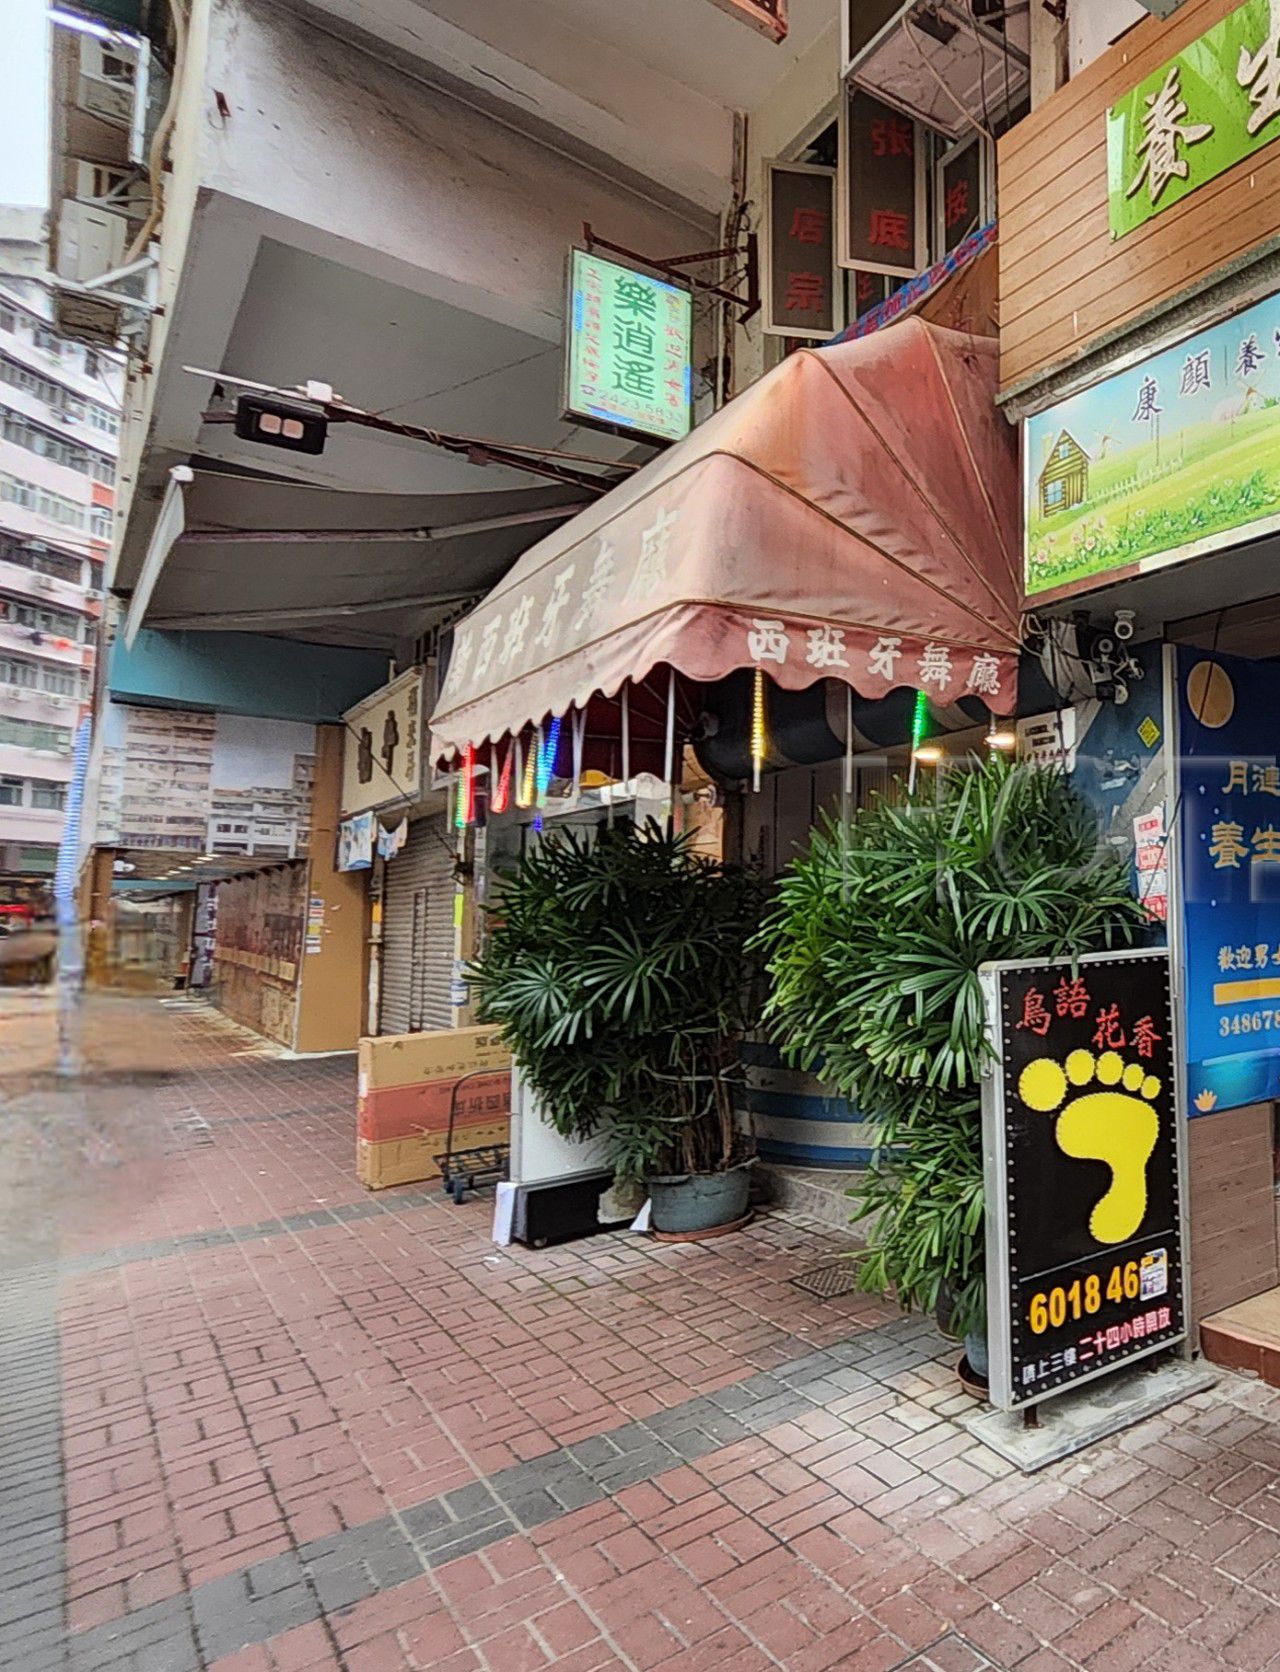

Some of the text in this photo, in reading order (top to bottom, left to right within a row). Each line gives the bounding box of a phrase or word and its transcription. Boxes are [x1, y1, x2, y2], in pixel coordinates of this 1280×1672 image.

[747, 617, 1001, 696] 西班牙舞廳
[1014, 976, 1163, 1058] 鳥語花香
[1030, 1274, 1101, 1334] 6018
[1079, 1306, 1171, 1360] 二十四小時開放
